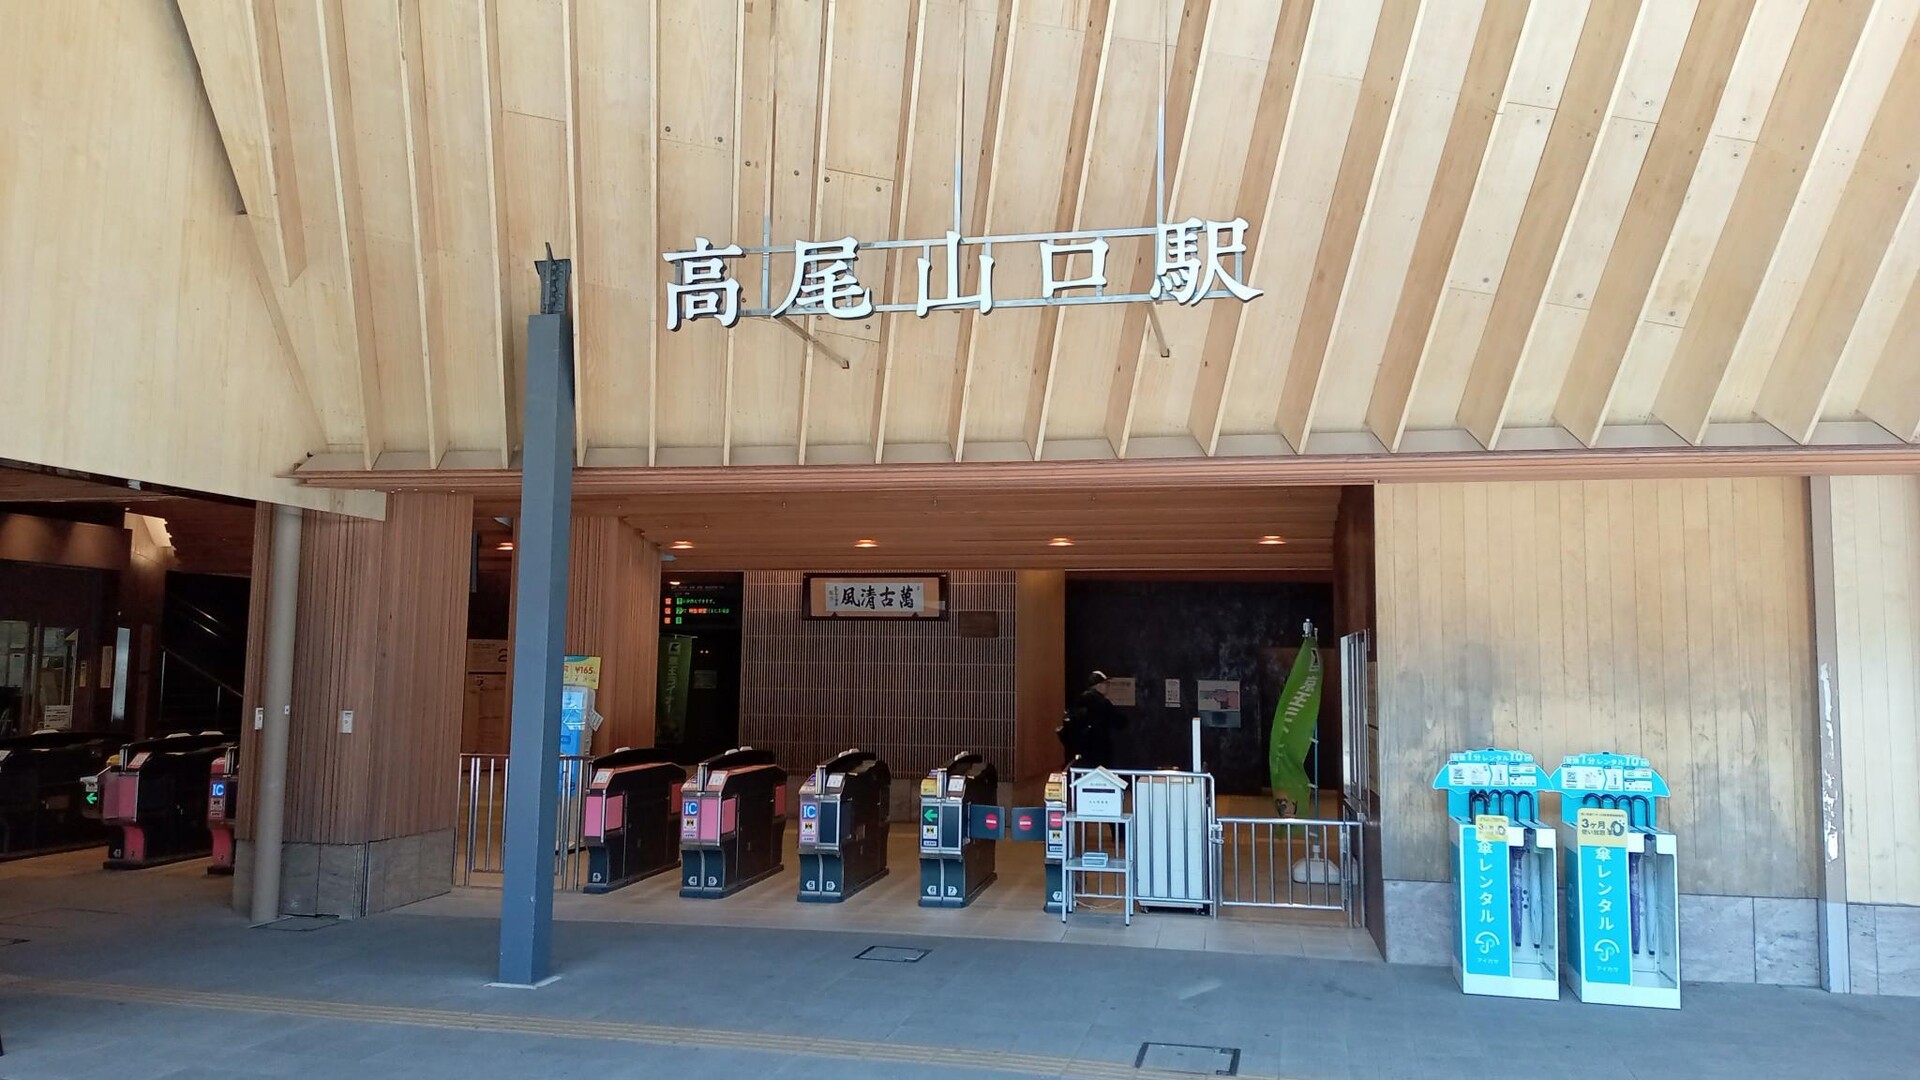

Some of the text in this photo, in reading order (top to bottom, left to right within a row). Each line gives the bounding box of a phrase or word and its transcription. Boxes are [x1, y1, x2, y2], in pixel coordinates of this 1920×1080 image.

[662, 216, 1265, 331] 高尾山口駅
[212, 783, 224, 796] IC
[684, 802, 697, 815] IC
[802, 805, 816, 818] IC
[1477, 841, 1495, 922] 傘レンタル
[1595, 847, 1615, 930] 傘レンタル
